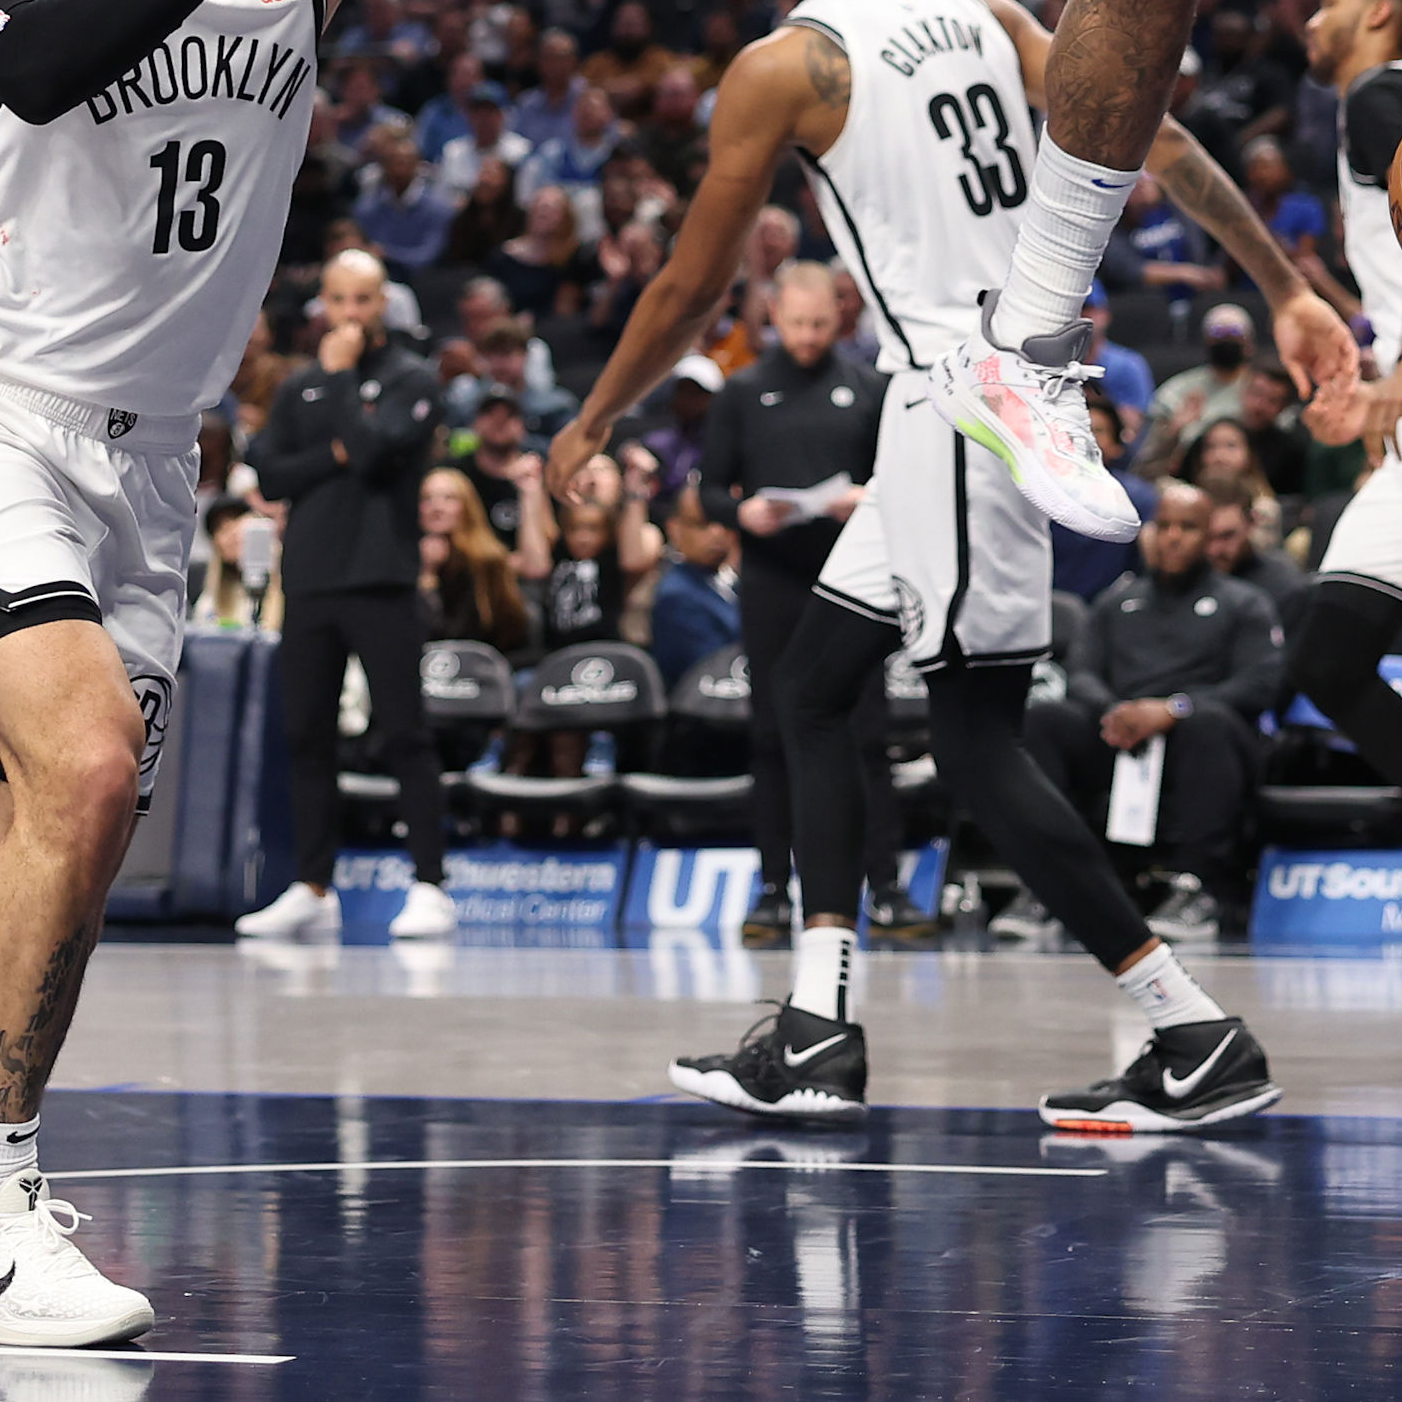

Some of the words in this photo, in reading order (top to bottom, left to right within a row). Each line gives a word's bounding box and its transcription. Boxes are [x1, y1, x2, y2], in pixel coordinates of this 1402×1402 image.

[86, 34, 312, 125] BROOKLYN
[880, 15, 985, 78] CLAXTON
[149, 139, 227, 255] 13
[928, 83, 1028, 217] 33
